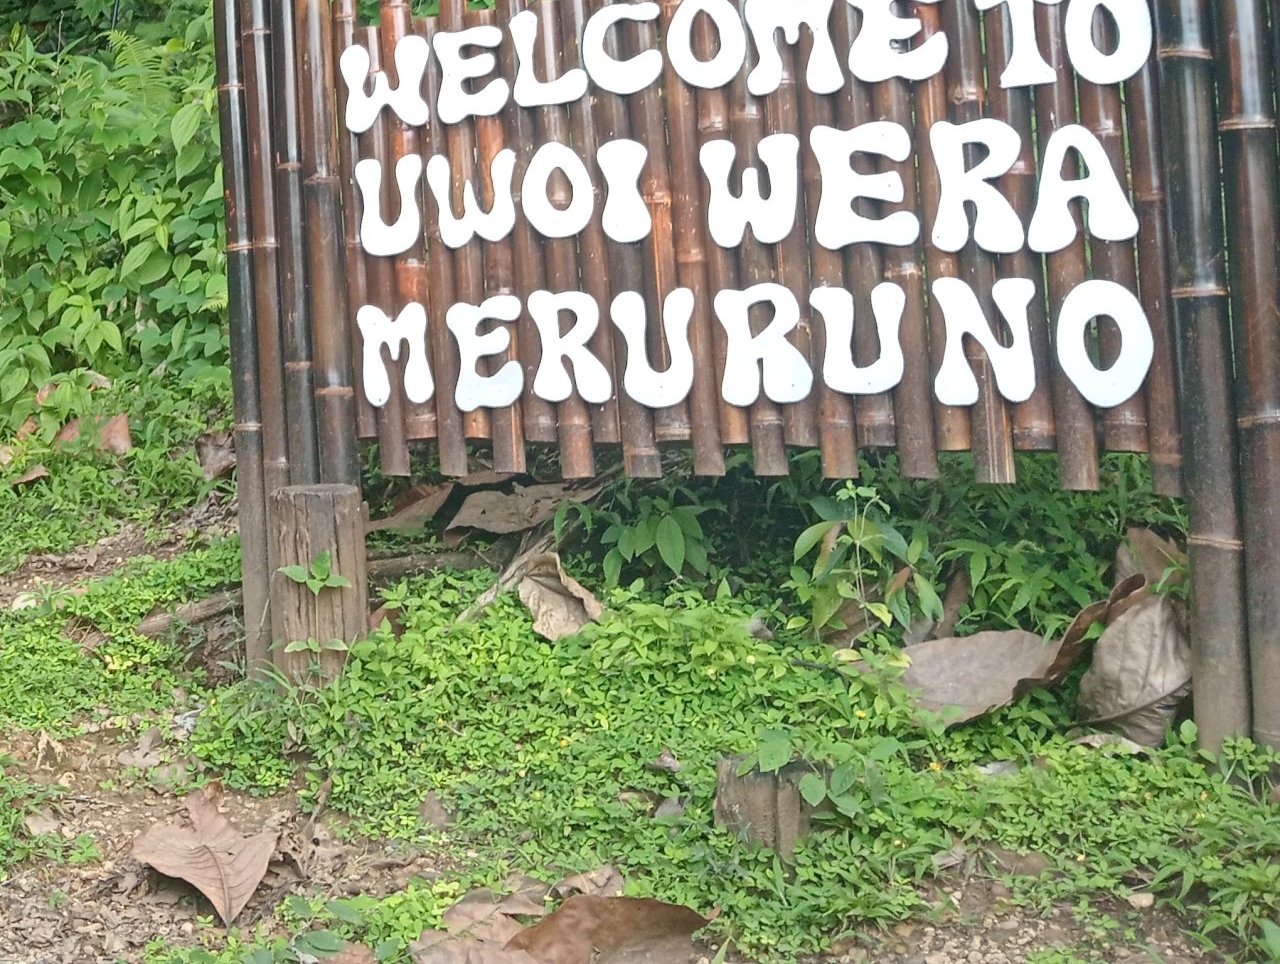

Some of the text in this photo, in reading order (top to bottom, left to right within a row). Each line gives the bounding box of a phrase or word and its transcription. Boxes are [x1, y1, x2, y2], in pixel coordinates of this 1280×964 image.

[354, 118, 1140, 256] UWOI WERA
[356, 278, 1155, 413] MERURUNO
